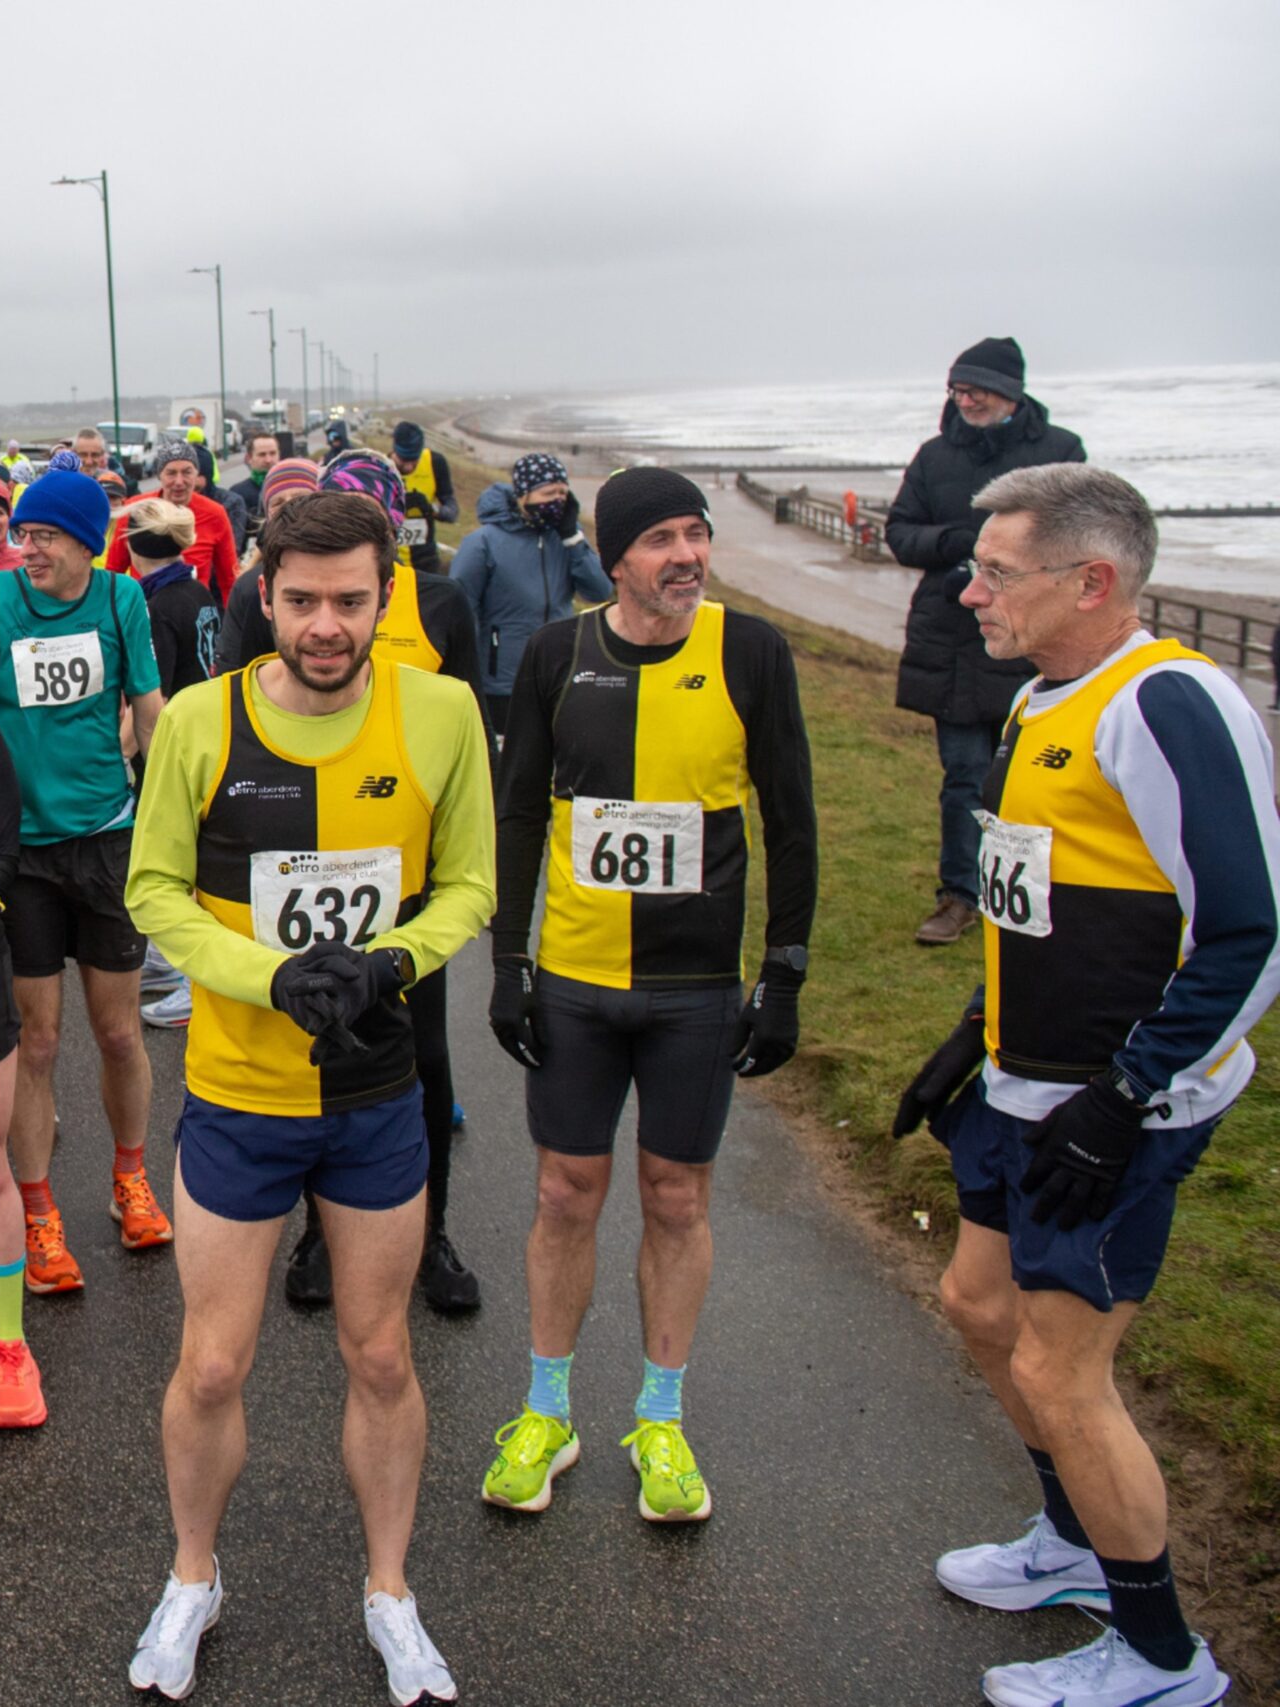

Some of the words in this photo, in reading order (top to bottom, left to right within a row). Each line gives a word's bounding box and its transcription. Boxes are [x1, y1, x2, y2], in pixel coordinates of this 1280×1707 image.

[34, 656, 90, 702] 589
[258, 785, 301, 793] aberdeen
[629, 811, 680, 820] aberdeen
[278, 861, 319, 875] metro
[322, 859, 378, 872] aberdeen
[590, 831, 674, 887] 681
[322, 871, 357, 881] running
[359, 870, 378, 879] club
[278, 884, 381, 949] 632
